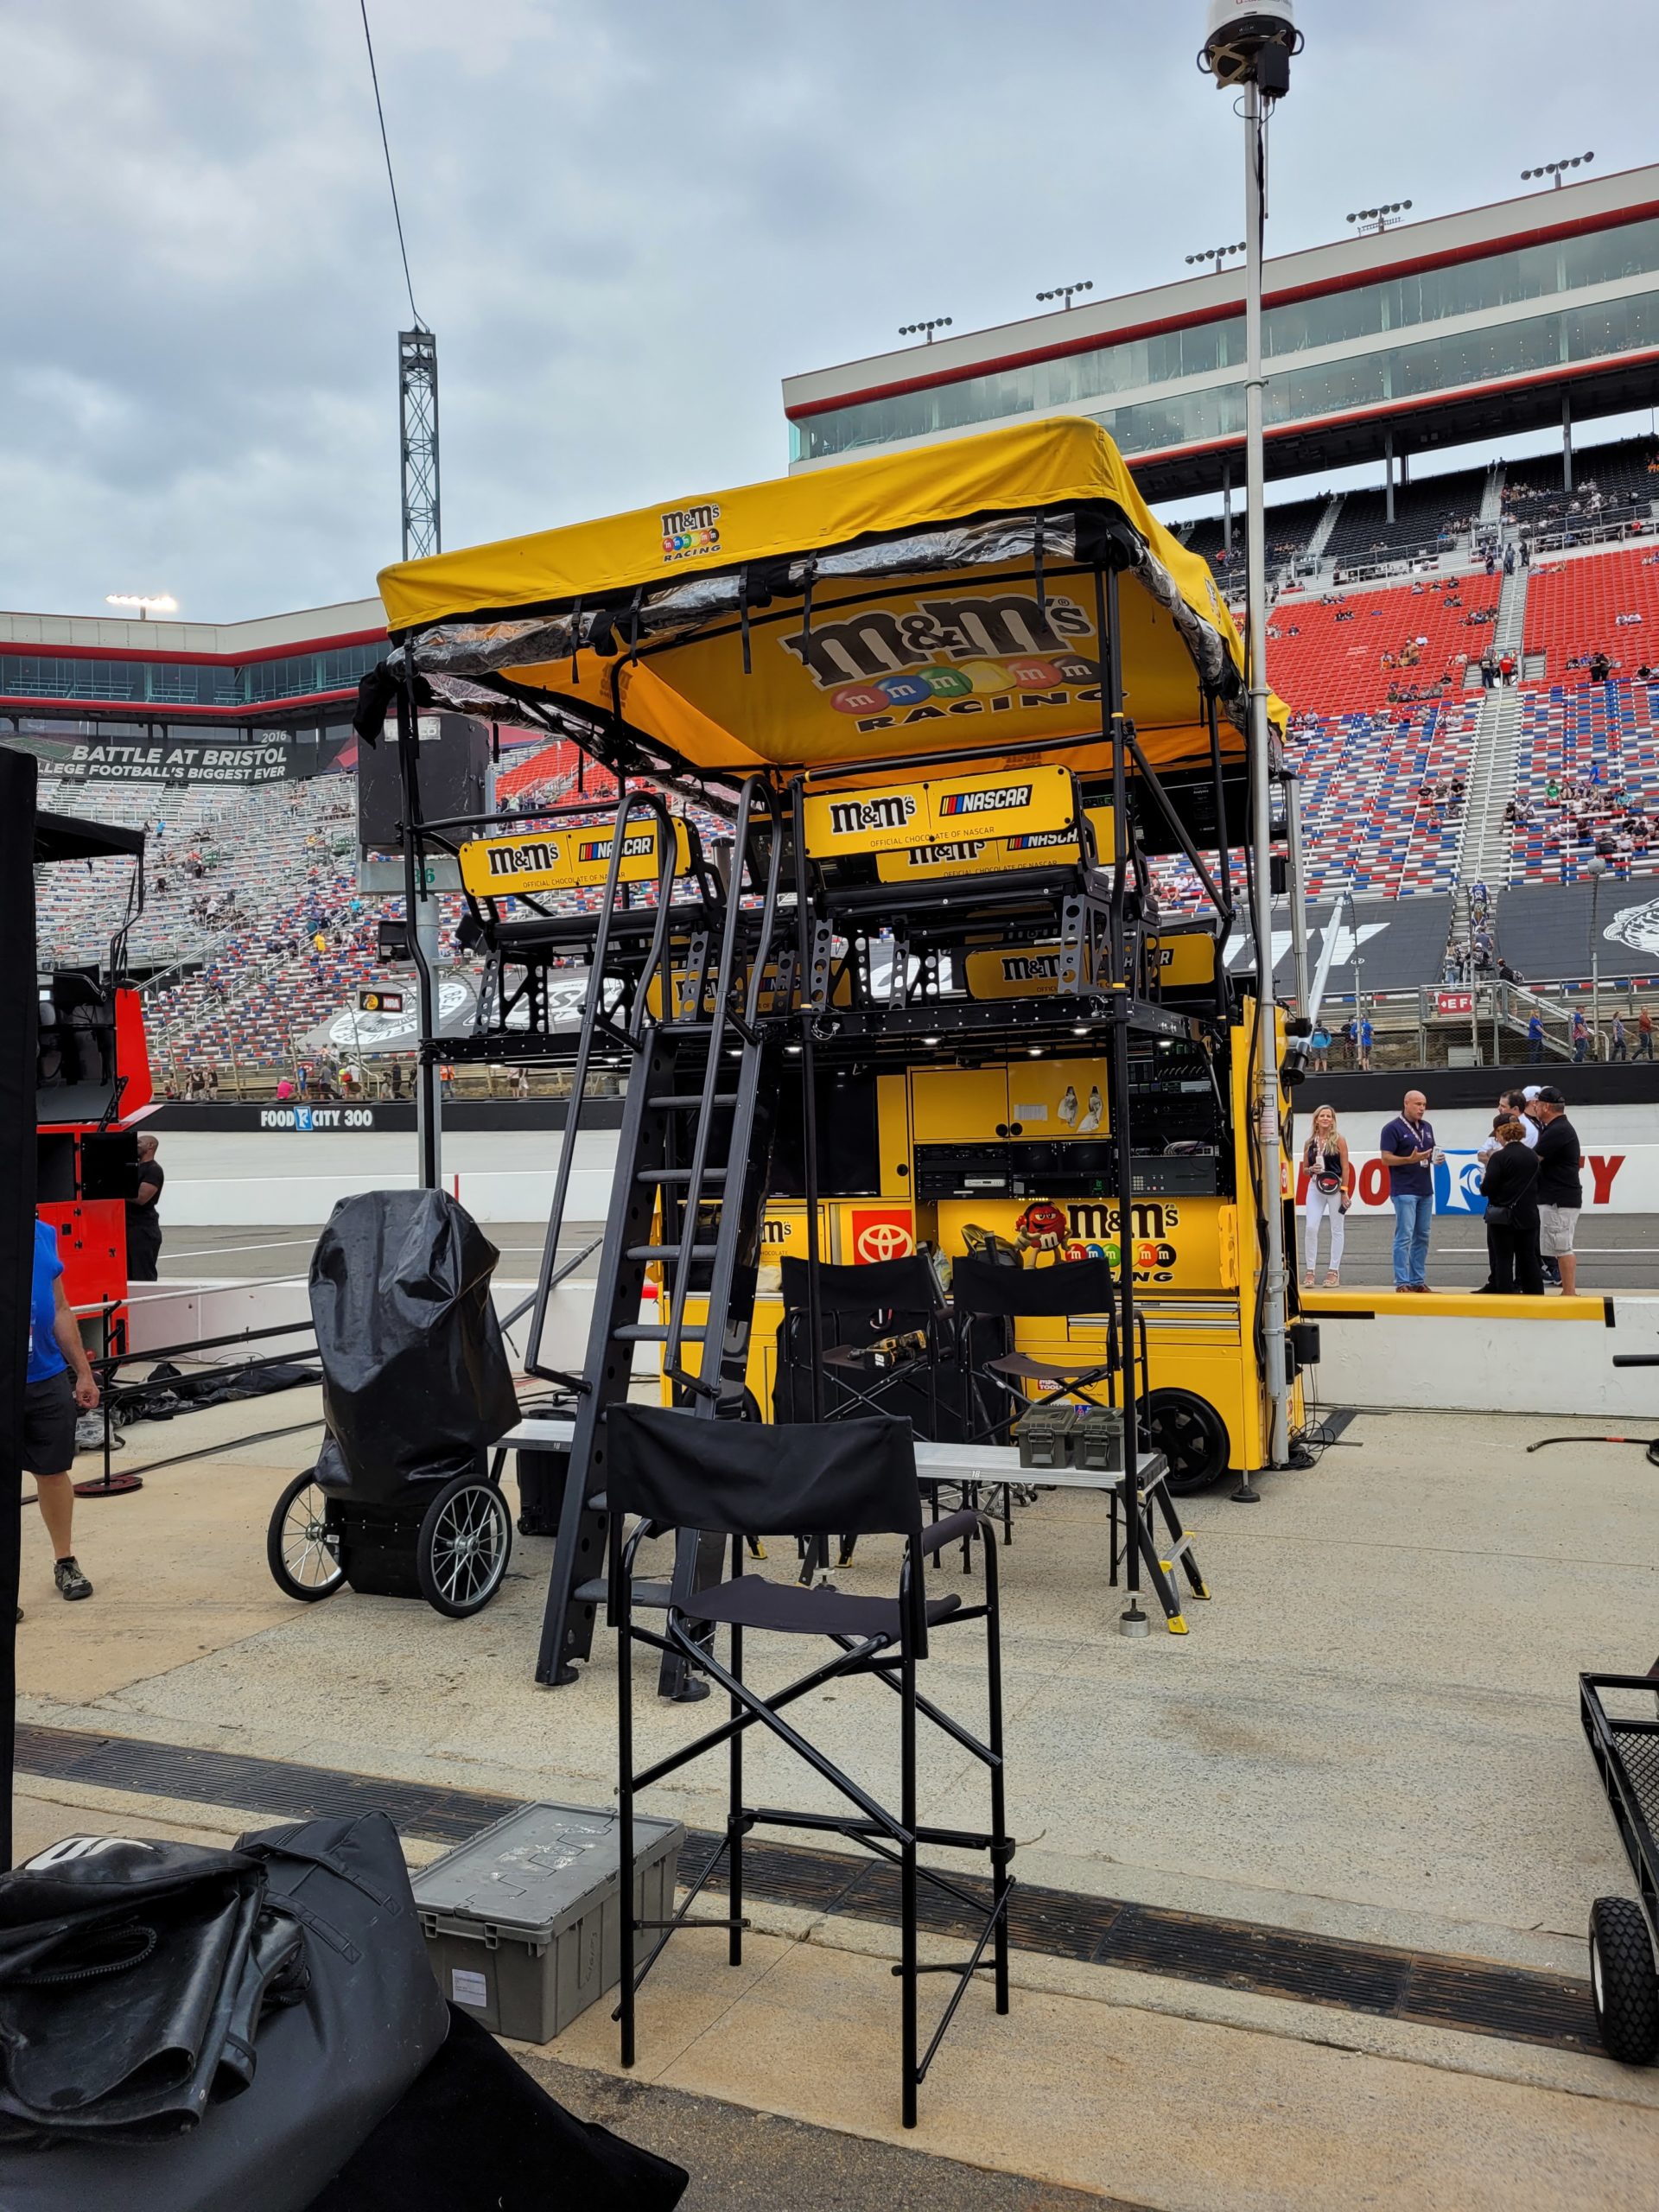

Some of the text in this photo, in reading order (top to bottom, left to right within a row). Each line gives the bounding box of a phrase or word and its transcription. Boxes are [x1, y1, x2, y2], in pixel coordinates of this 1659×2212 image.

[664, 544, 721, 562] RACING
[262, 730, 287, 744] 2016
[72, 745, 287, 766] BATTLE AT BRISTOL
[37, 762, 285, 779] LLEGE FOOTBALL'S BIGGEST EVER
[963, 786, 1029, 811] NASCAR
[870, 837, 902, 848] OFFICIAL
[950, 830, 962, 838] OF
[963, 826, 995, 837] NASCAR
[523, 879, 550, 889] OFFICIAL
[551, 875, 588, 886] CHOCOLATE
[261, 1109, 372, 1127] FOOD CITY 300
